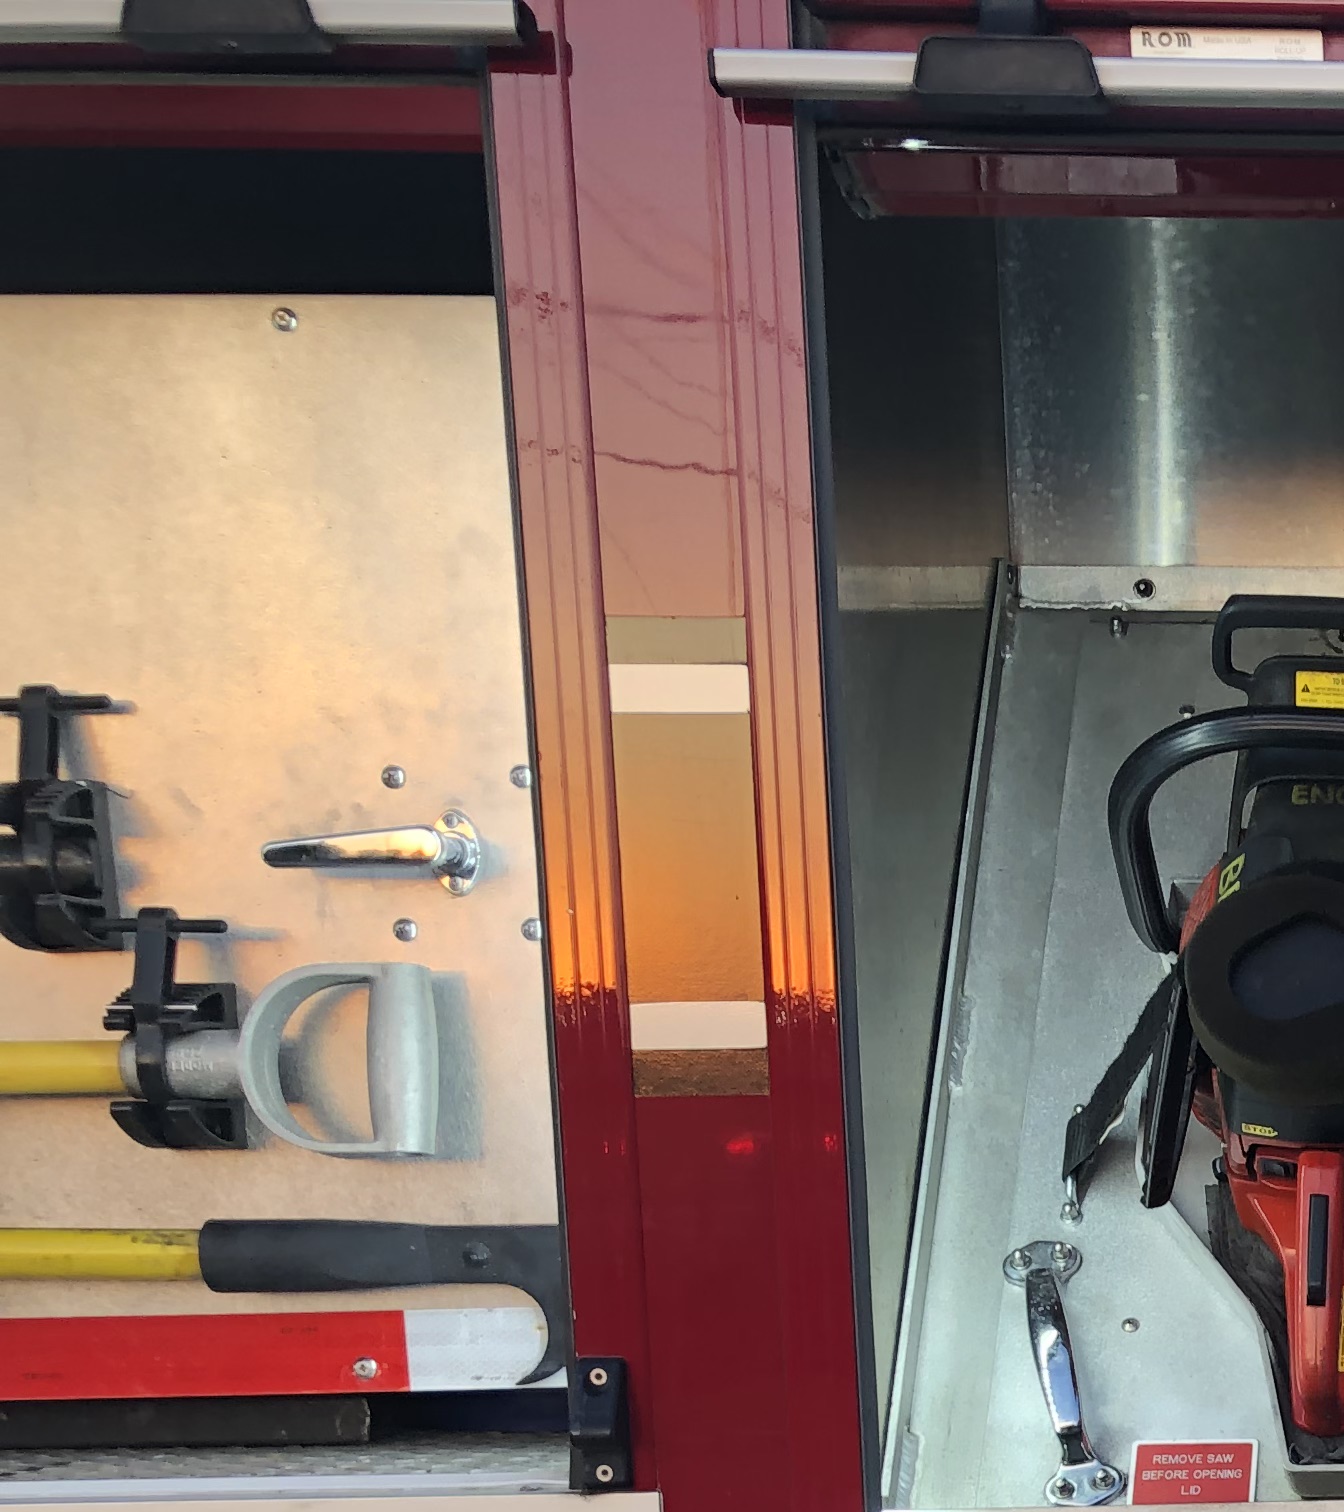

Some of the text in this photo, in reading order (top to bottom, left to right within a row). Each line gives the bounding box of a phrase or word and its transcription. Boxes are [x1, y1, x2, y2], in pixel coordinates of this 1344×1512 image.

[1141, 30, 1192, 48] ROM
[1151, 1453, 1234, 1465] REMOVE SAW
[1141, 1468, 1242, 1481] BEFORE OPENING
[1180, 1485, 1201, 1496] LID
